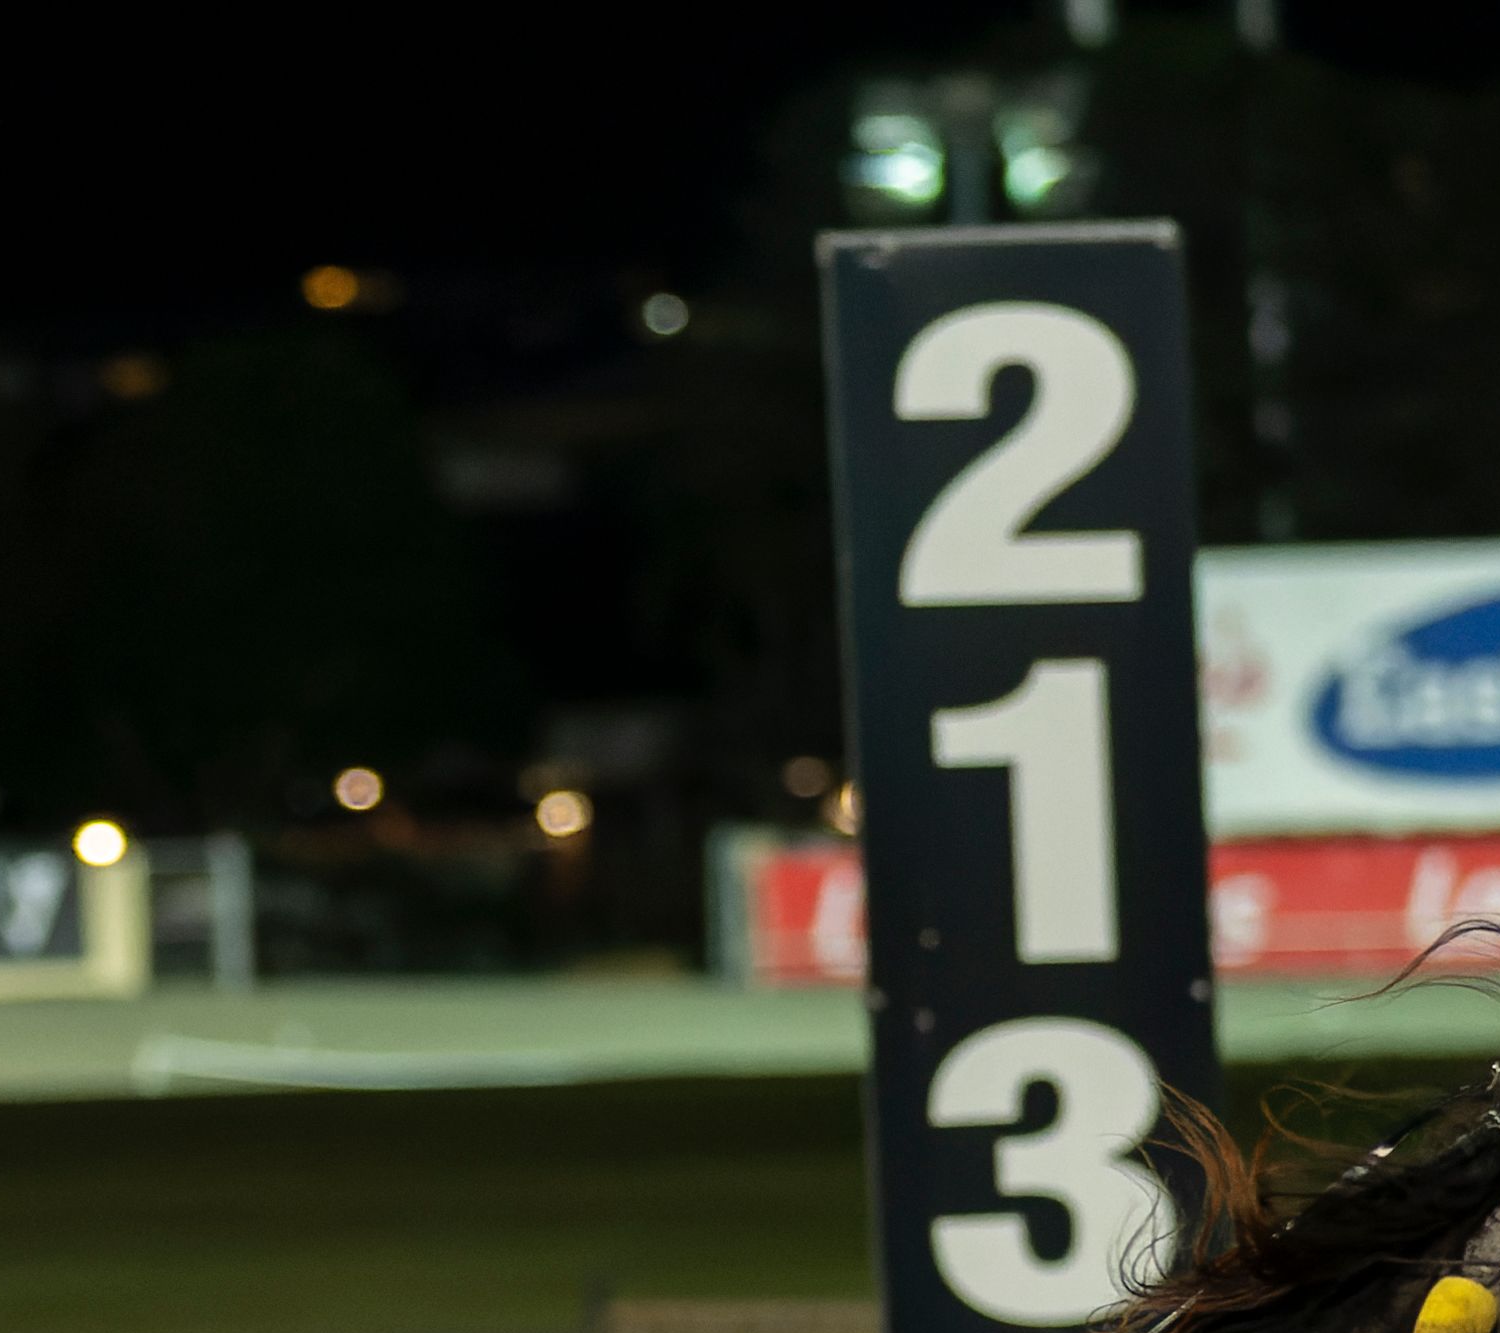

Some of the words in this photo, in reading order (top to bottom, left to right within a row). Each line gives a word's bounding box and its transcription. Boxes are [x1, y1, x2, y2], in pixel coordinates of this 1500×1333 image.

[891, 300, 1144, 608] 2
[930, 657, 1120, 966] 1
[925, 1014, 1179, 1328] 3
